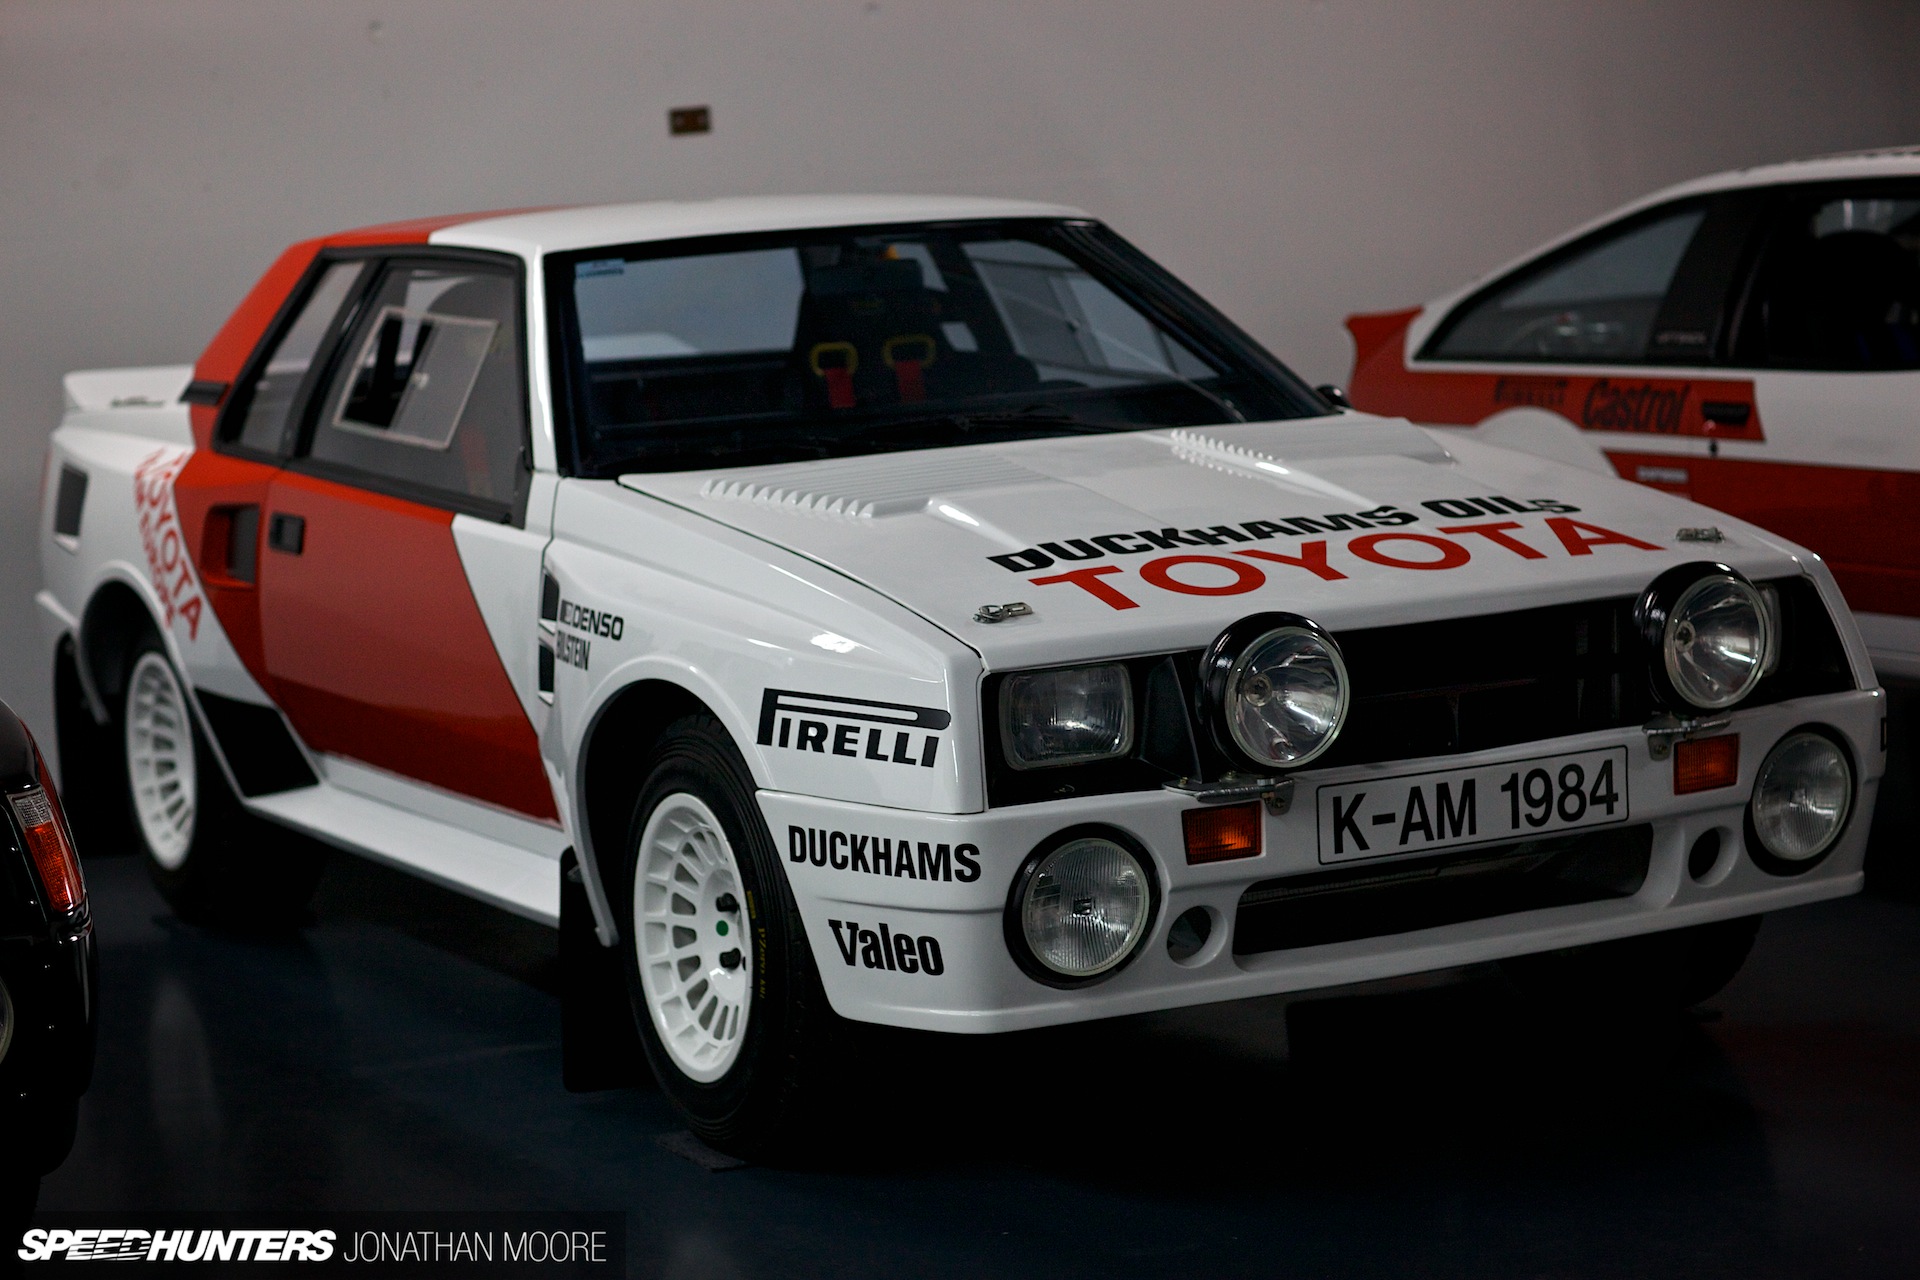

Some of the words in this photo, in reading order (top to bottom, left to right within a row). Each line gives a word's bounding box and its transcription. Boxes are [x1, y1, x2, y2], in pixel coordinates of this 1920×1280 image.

[1583, 379, 1691, 432] Castrol
[987, 506, 1419, 573] DUCKHAMS
[1028, 518, 1667, 611] TOYOTA
[572, 604, 624, 641] DENSO
[757, 688, 952, 768] PIRELLI
[1332, 778, 1477, 854] K-AM
[1501, 759, 1619, 829] 1984
[788, 825, 982, 883] DUCKHAMS
[828, 918, 945, 976] Valeo
